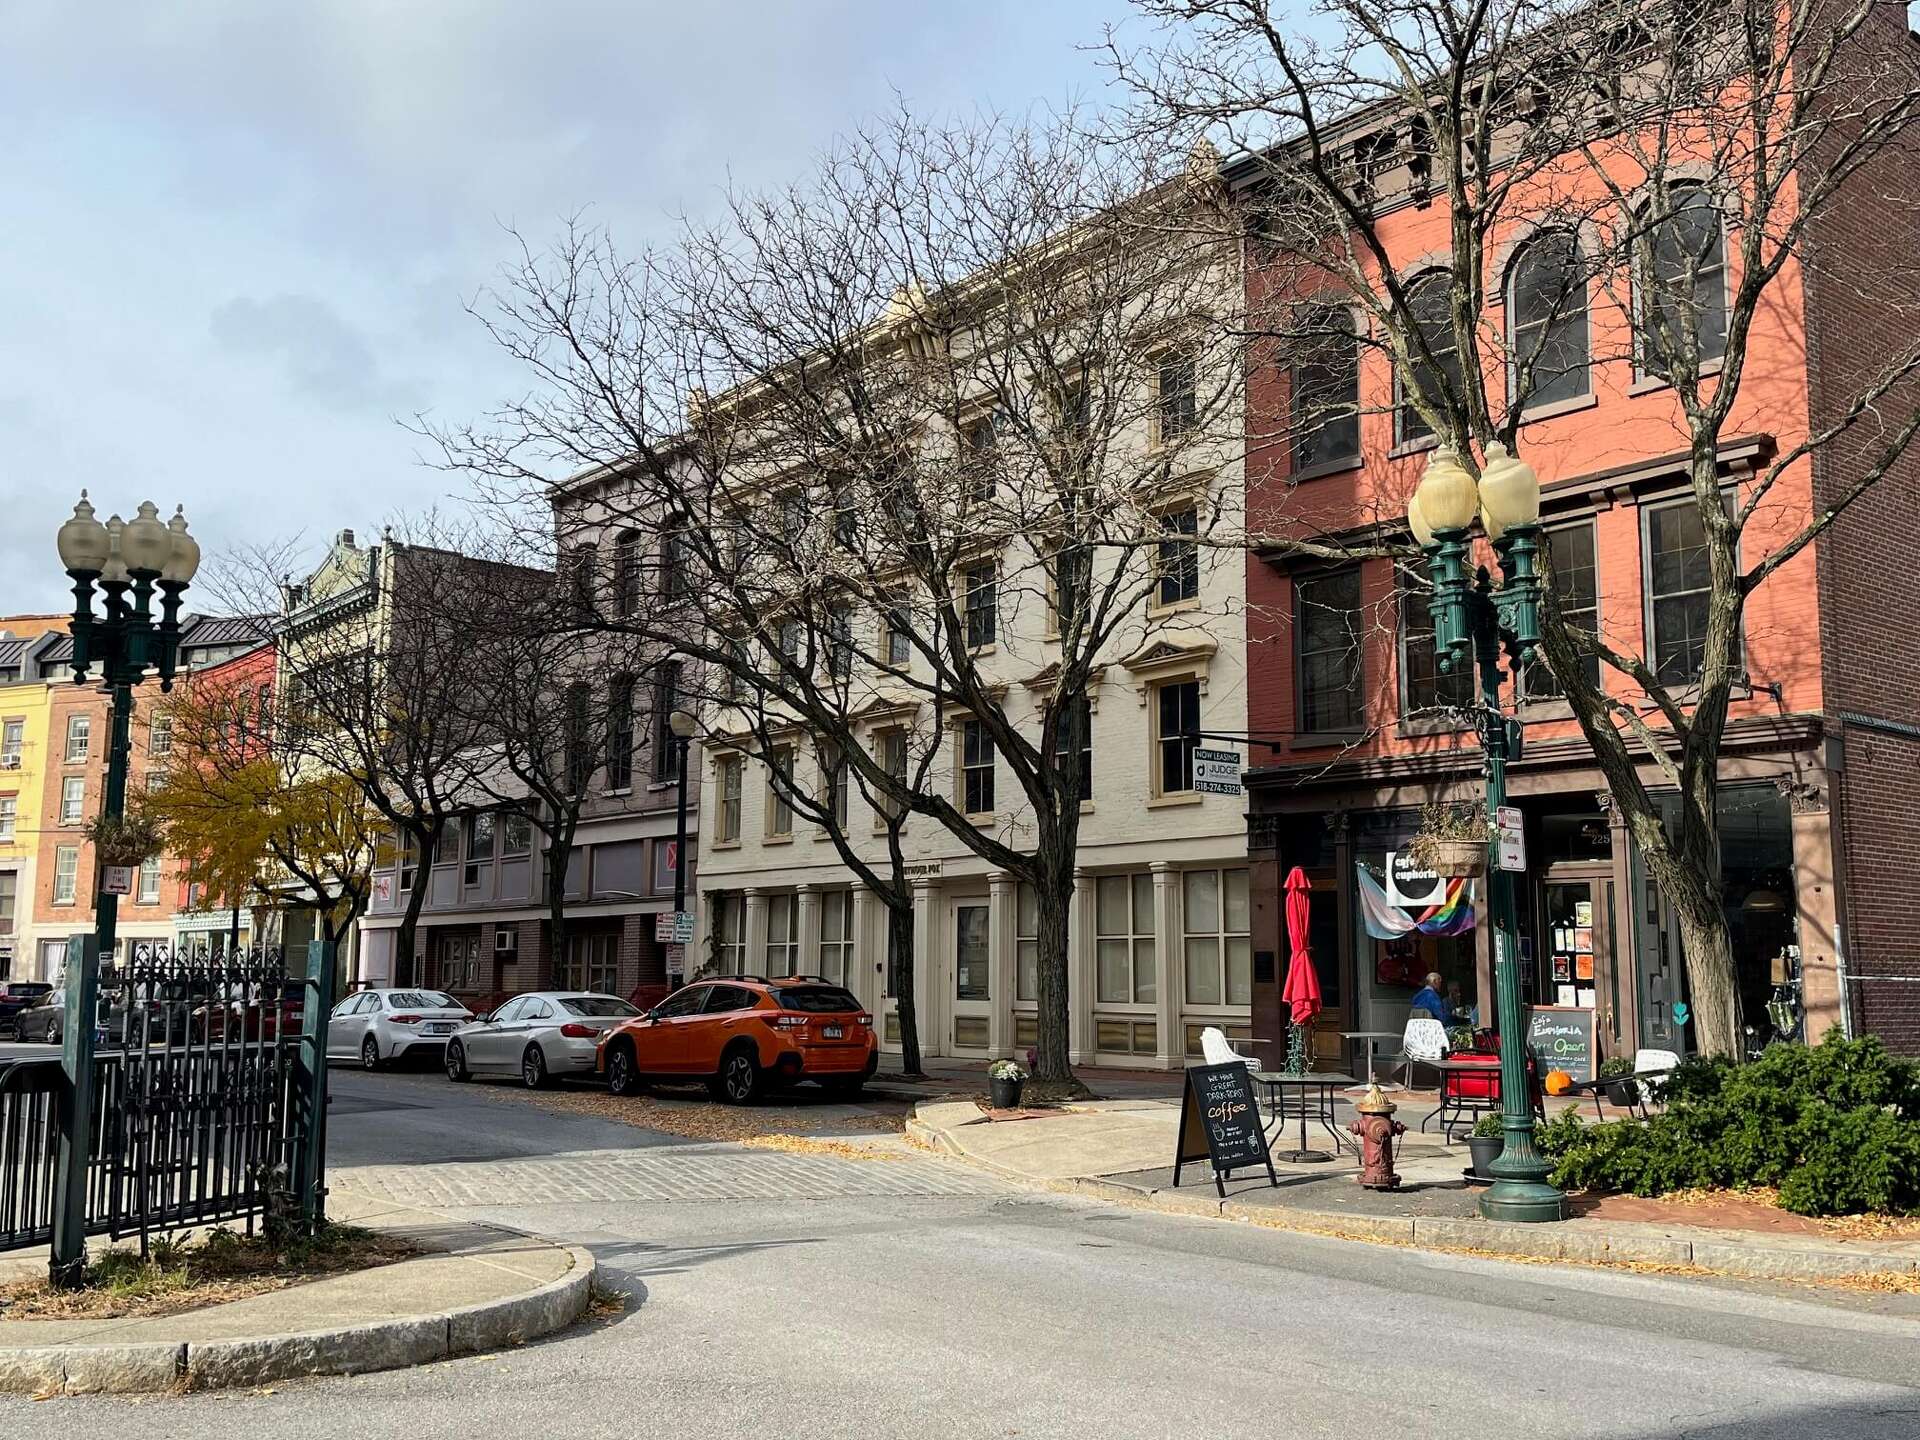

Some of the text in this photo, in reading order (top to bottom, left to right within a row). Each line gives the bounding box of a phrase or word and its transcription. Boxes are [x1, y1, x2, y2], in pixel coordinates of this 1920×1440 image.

[1196, 750, 1238, 762] NOW LEASING
[1209, 764, 1238, 775] JUDGE
[1196, 781, 1239, 793] 518-274-3325
[1591, 834, 1610, 845] 225
[1395, 869, 1437, 882] euphoria
[1554, 1038, 1585, 1056] Open
[1211, 1080, 1236, 1091] GREAT
